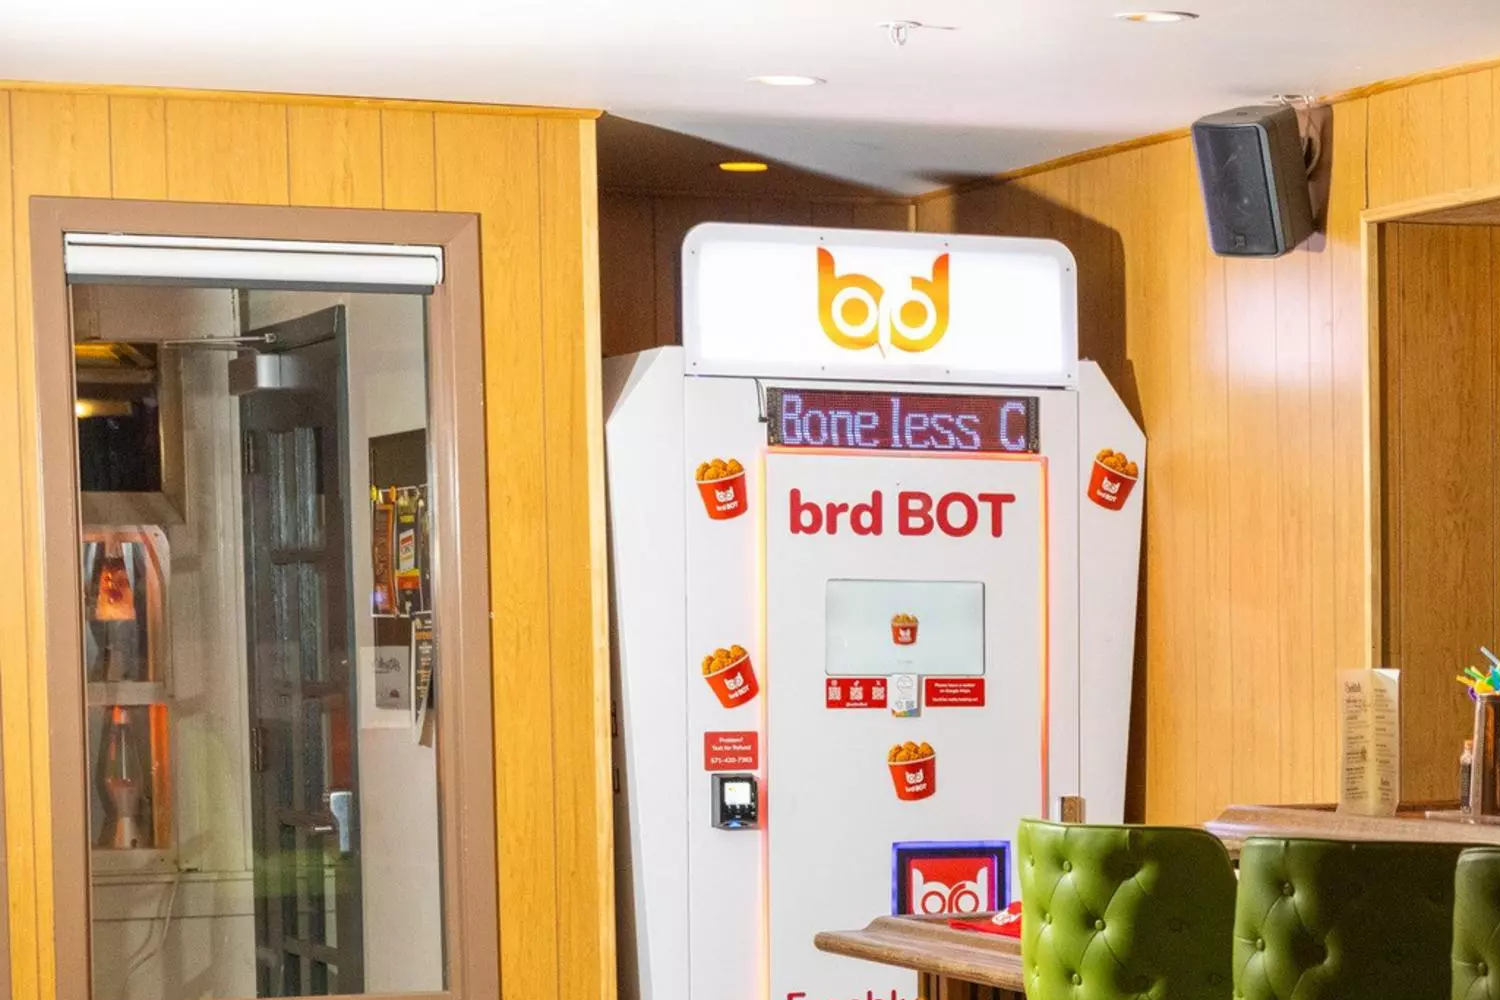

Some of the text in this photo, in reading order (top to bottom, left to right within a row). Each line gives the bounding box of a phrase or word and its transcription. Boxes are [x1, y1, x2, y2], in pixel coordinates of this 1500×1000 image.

[782, 392, 1026, 450] Boneless C
[789, 488, 1016, 538] brd BOT
